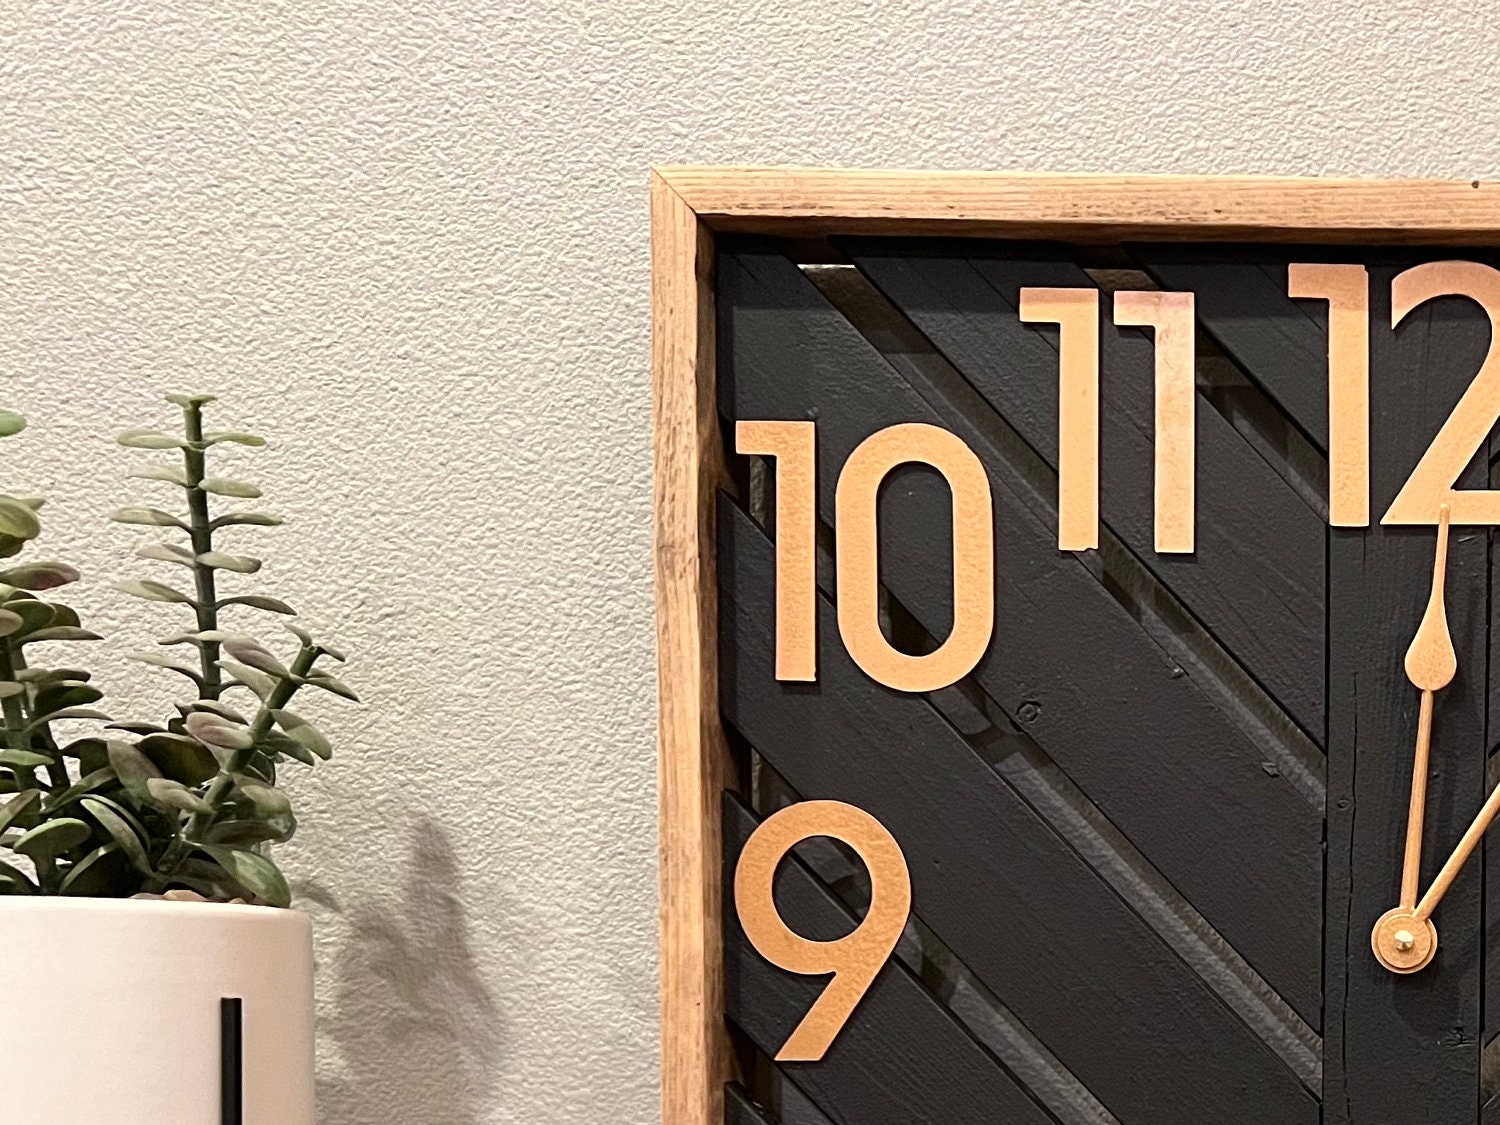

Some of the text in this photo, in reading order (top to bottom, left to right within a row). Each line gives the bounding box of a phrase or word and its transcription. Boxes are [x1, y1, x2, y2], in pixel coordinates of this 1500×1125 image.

[1020, 288, 1196, 554] 11
[735, 420, 995, 692] 10
[734, 799, 912, 1063] 9
